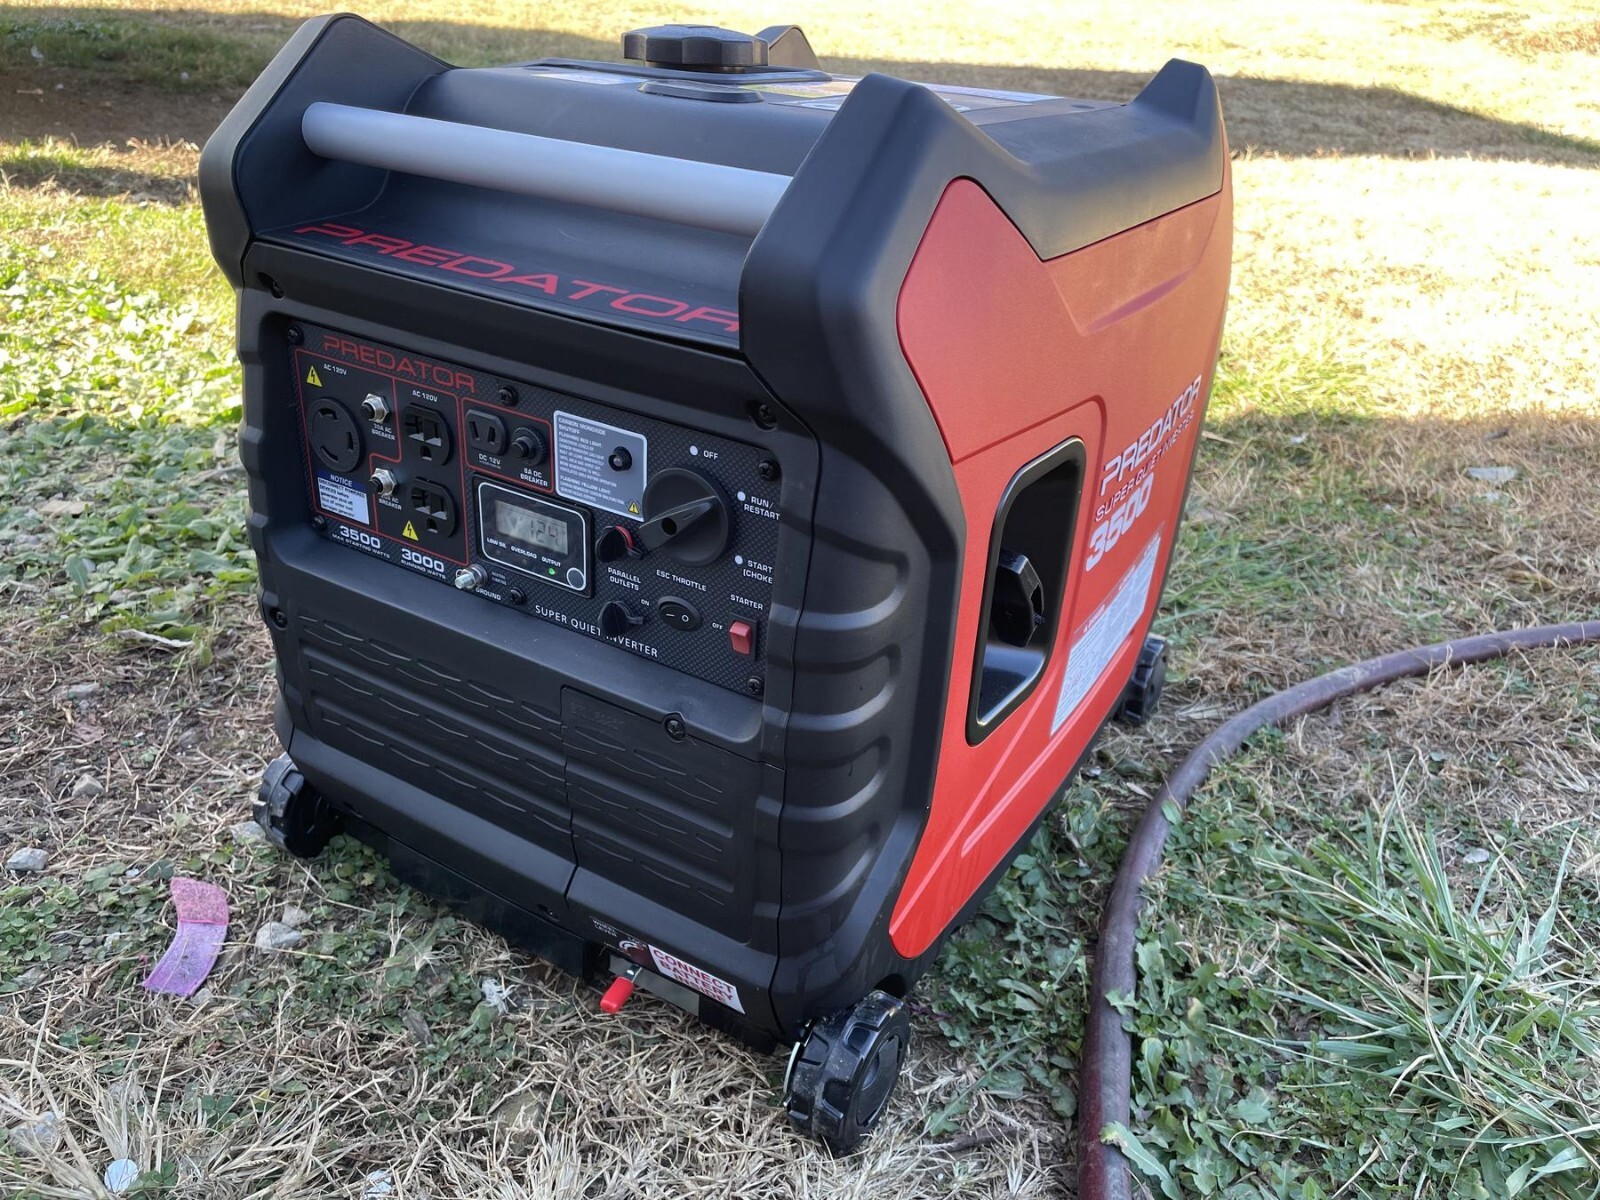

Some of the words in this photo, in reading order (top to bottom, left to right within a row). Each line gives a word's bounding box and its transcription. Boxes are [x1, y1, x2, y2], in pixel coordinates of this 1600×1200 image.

[293, 223, 739, 333] PREDATOR
[323, 335, 475, 393] PREDATOR
[332, 366, 347, 376] 120V
[422, 392, 438, 402] 120V
[371, 428, 395, 440] BREAKER
[1100, 374, 1202, 496] PREDATOR
[489, 456, 500, 465] 12V
[703, 450, 718, 460] OFF
[330, 474, 352, 487] NOTICE
[520, 474, 548, 487] BREAKER
[378, 498, 402, 510] BREAKER
[751, 496, 774, 509] RUN/
[1095, 480, 1136, 523] SUPER
[744, 504, 780, 520] RESTART
[1086, 472, 1154, 572] 3500
[332, 533, 344, 542] MAX
[346, 538, 371, 551] STARTING
[372, 549, 390, 558] WATTS
[340, 526, 380, 549] 3500
[487, 537, 498, 546] LOW
[402, 548, 444, 573] 3000
[511, 546, 537, 559] OVERLOAD
[401, 559, 426, 572] RUNNING
[427, 570, 446, 579] WATTS
[542, 556, 561, 567] OUTPUT
[748, 560, 773, 573] START
[607, 567, 641, 584] PARALLEL
[609, 576, 639, 591] OUTLETS
[656, 569, 671, 581] ESC
[672, 574, 707, 592] THROTTLE
[476, 587, 501, 600] GROUND
[730, 594, 763, 610] STARTER
[535, 604, 568, 624] SUPER
[570, 618, 600, 636] QUIET
[606, 634, 658, 658] VERTER
[653, 950, 734, 993] CONNECT
[660, 960, 733, 1000] BATTERY
[674, 974, 725, 1002] INSIDE
